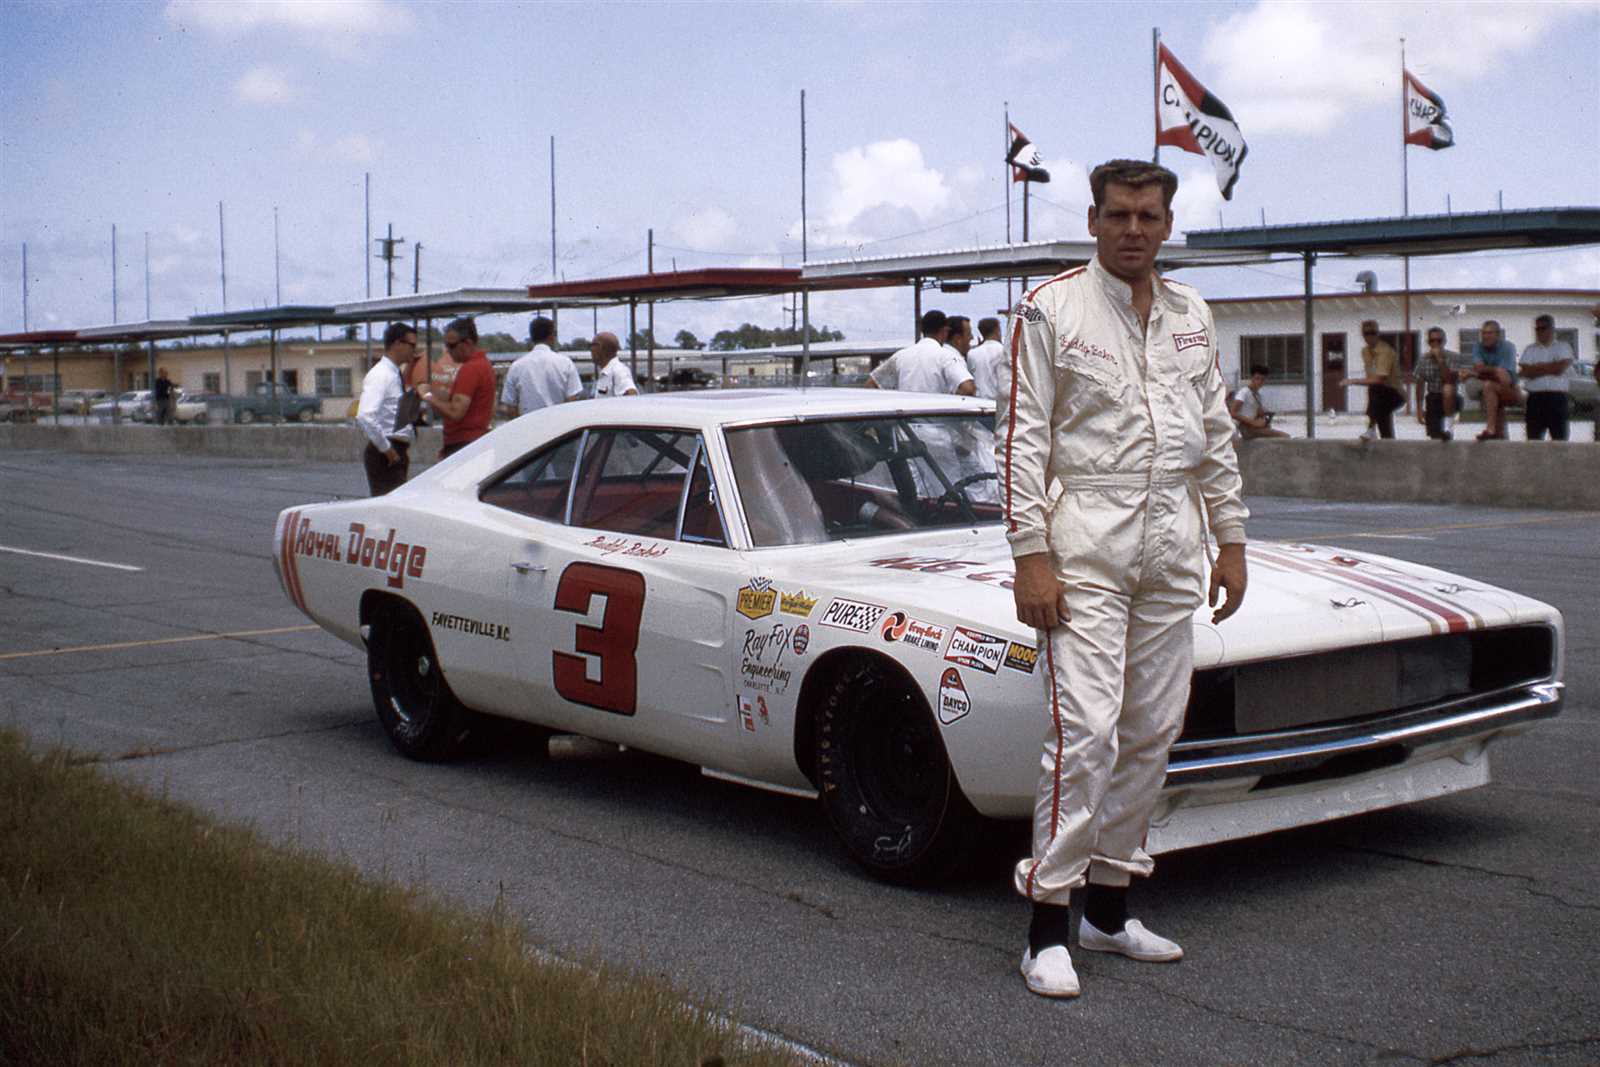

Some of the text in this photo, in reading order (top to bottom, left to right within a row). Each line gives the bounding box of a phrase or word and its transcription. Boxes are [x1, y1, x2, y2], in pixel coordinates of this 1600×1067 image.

[347, 522, 427, 589] Dodge
[823, 602, 862, 626] PURE
[553, 561, 647, 717] 3
[742, 628, 769, 661] Ray
[768, 623, 793, 663] Fox
[951, 638, 1001, 661] CHAMPION
[741, 657, 791, 688] Engineering
[943, 695, 967, 712] DAYCO
